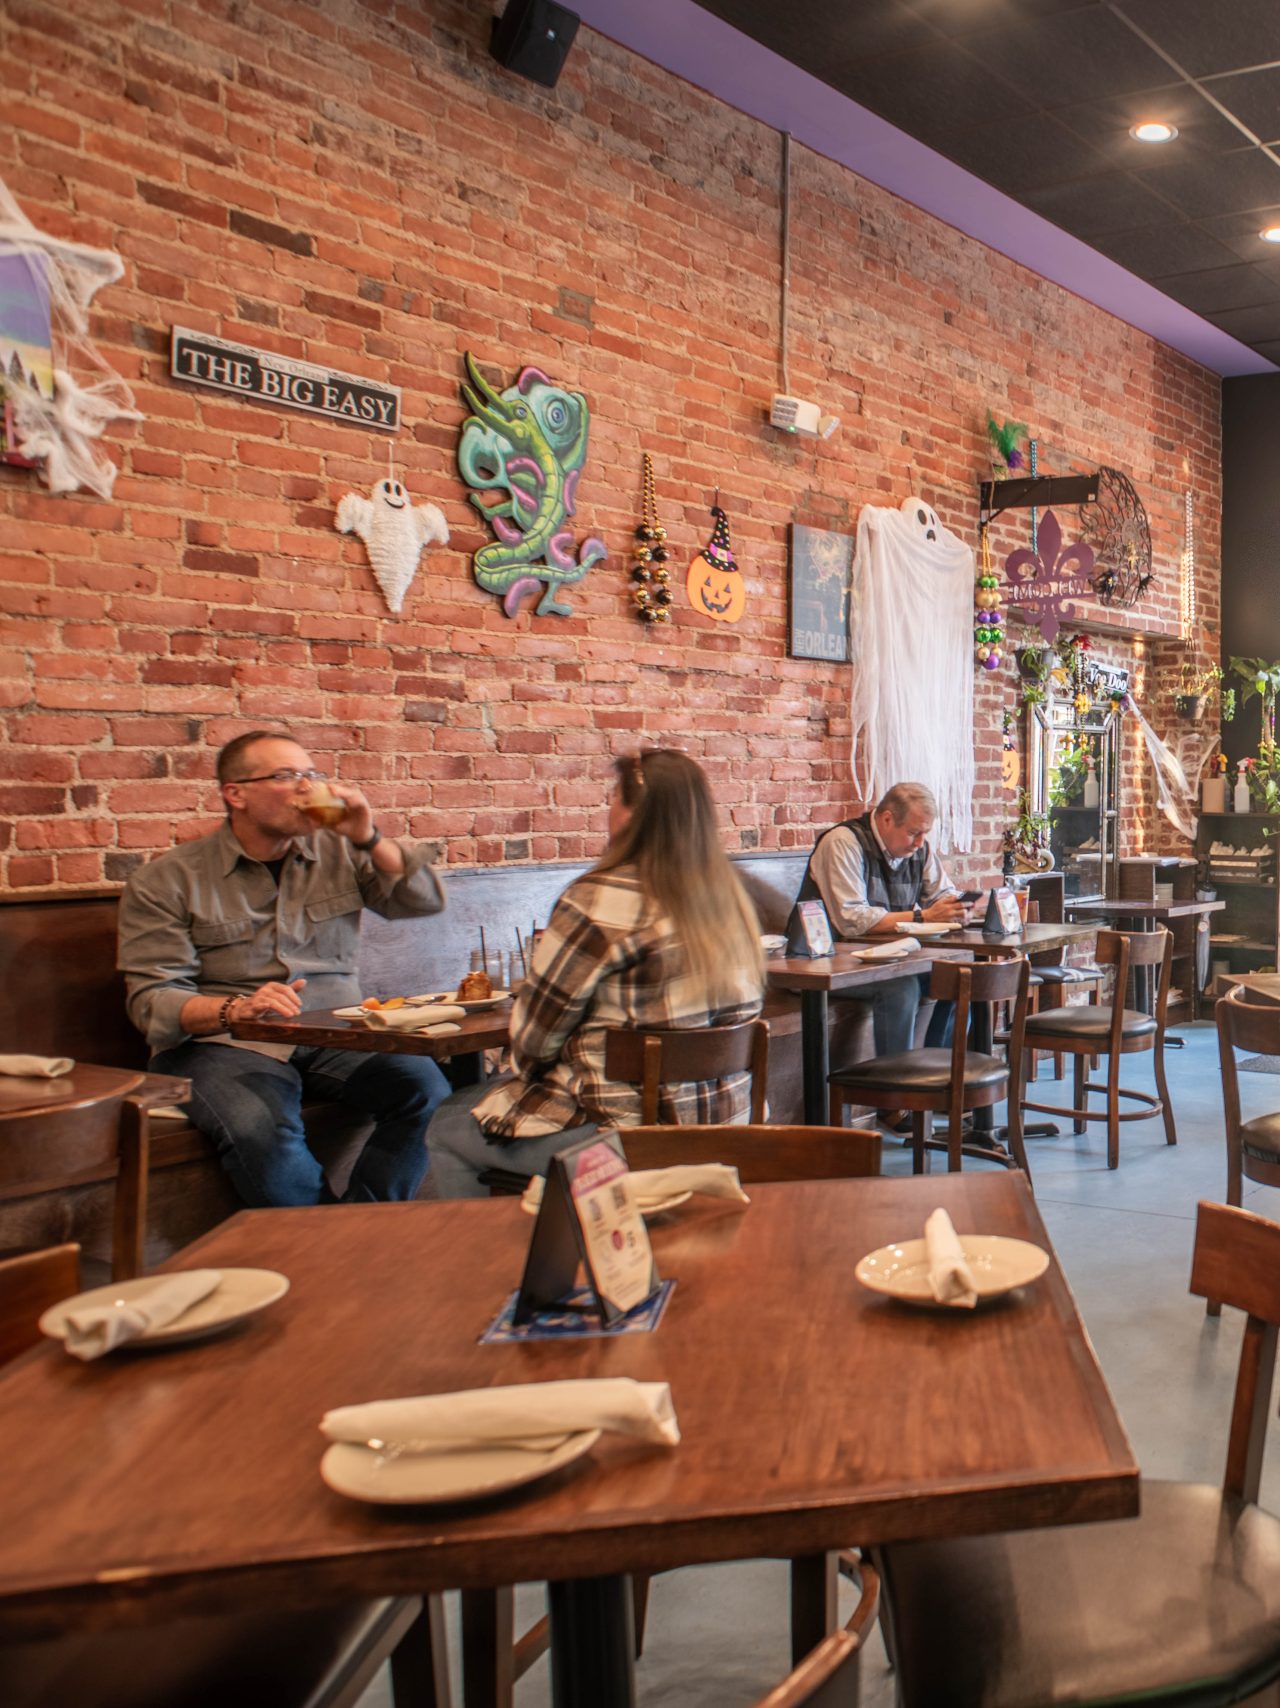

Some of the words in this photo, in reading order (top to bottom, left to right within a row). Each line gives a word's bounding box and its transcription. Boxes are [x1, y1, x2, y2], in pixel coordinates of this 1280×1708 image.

[181, 347, 253, 390] THE
[259, 368, 315, 404] BIG
[322, 384, 395, 425] EASY
